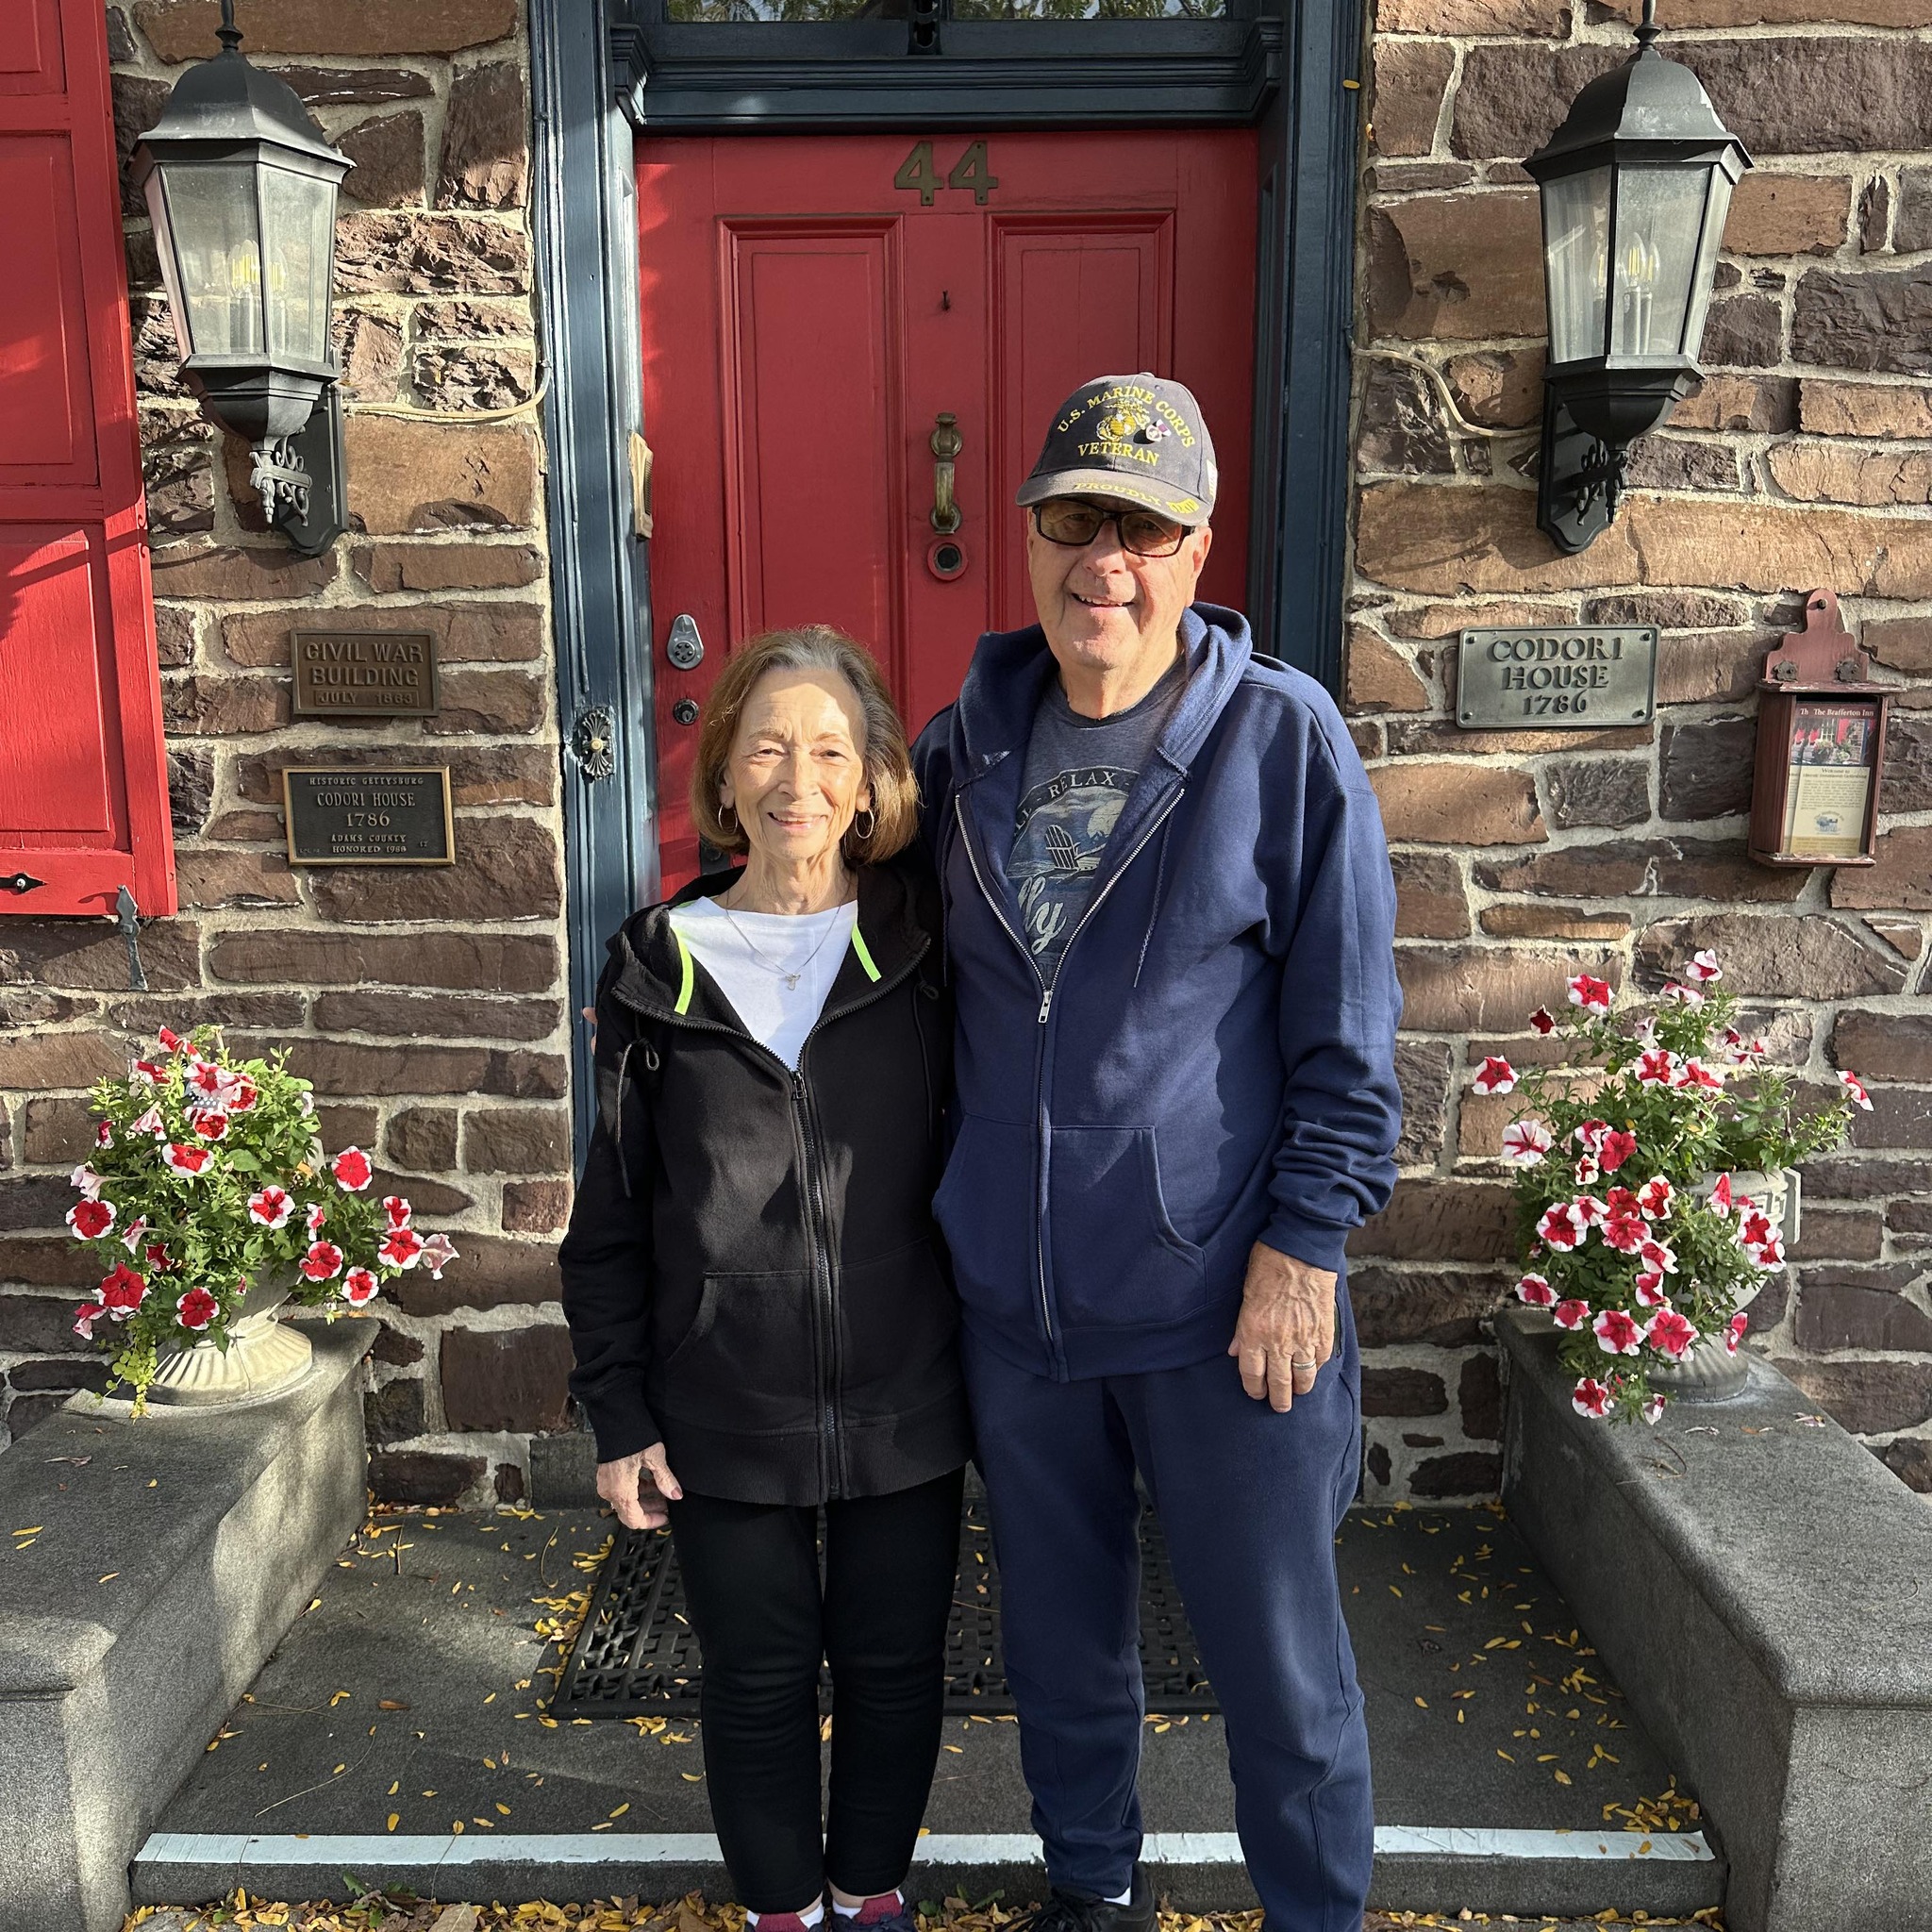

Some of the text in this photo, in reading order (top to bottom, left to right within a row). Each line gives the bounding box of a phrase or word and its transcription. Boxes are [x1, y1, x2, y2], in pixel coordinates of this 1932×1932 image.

[894, 141, 998, 207] 44
[1058, 385, 1196, 448] U.S. MARINE CORPS
[1077, 441, 1160, 467] VETERAN
[1074, 482, 1162, 507] PROUDLY
[306, 641, 424, 663] CIVIL WAR
[1487, 636, 1625, 662] CODORI
[311, 666, 419, 687] BUILDING
[1501, 664, 1609, 691] HOUSE
[319, 691, 413, 705] JULY 1863
[1522, 690, 1588, 716] 1786
[1814, 708, 1874, 717] The Brafferton Inn
[309, 776, 425, 786] HISTORIC GETTYSBURG
[1047, 770, 1118, 799] RELAX
[317, 792, 416, 807] CODORI HOUSE
[346, 809, 391, 827] 1786
[331, 834, 407, 842] ADAMS COUNTY
[332, 845, 381, 854] HONORED
